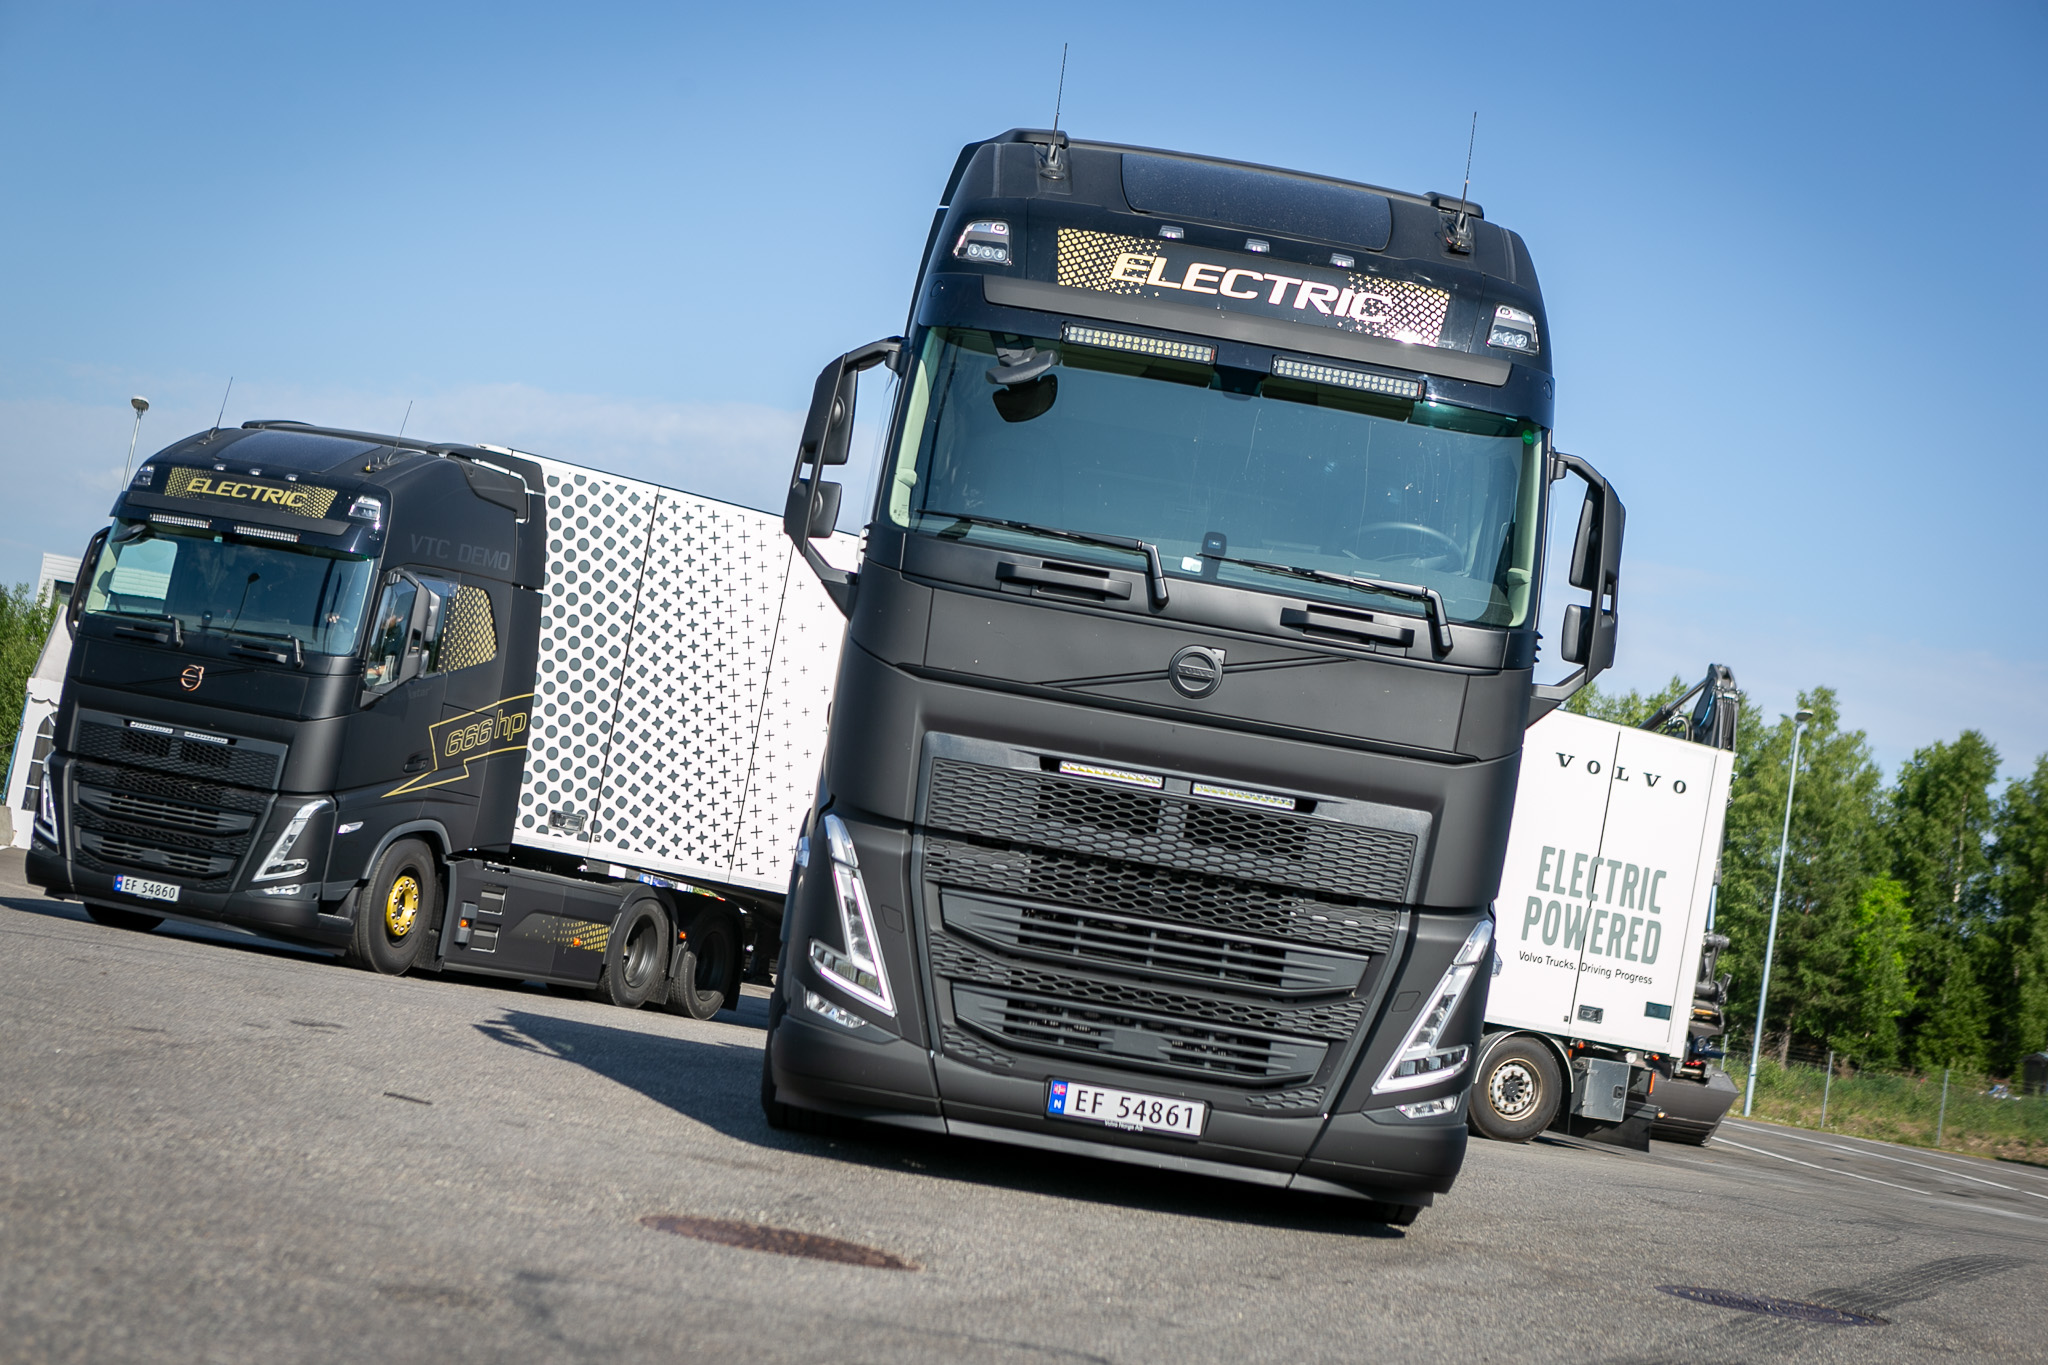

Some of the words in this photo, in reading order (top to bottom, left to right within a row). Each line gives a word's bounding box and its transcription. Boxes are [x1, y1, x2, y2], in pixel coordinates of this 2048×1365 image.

[1110, 252, 1393, 322] ELECTRIC
[187, 478, 308, 507] ELECTRIC
[410, 533, 451, 559] VTC
[457, 544, 511, 571] DEMO
[445, 718, 494, 757] 666
[494, 708, 527, 741] hp
[1556, 752, 1687, 794] VOLVO
[124, 878, 138, 891] EF
[141, 882, 176, 899] 54860
[1536, 845, 1667, 915] ELECTRIC
[1521, 895, 1662, 965] POWERED
[1519, 950, 1543, 964] Volvo
[1545, 955, 1577, 971] Trucks.
[1579, 962, 1612, 979] Driving
[1614, 968, 1653, 985] Progress
[1053, 1099, 1062, 1110] N
[1075, 1089, 1104, 1114] EF
[1116, 1096, 1193, 1129] 54861
